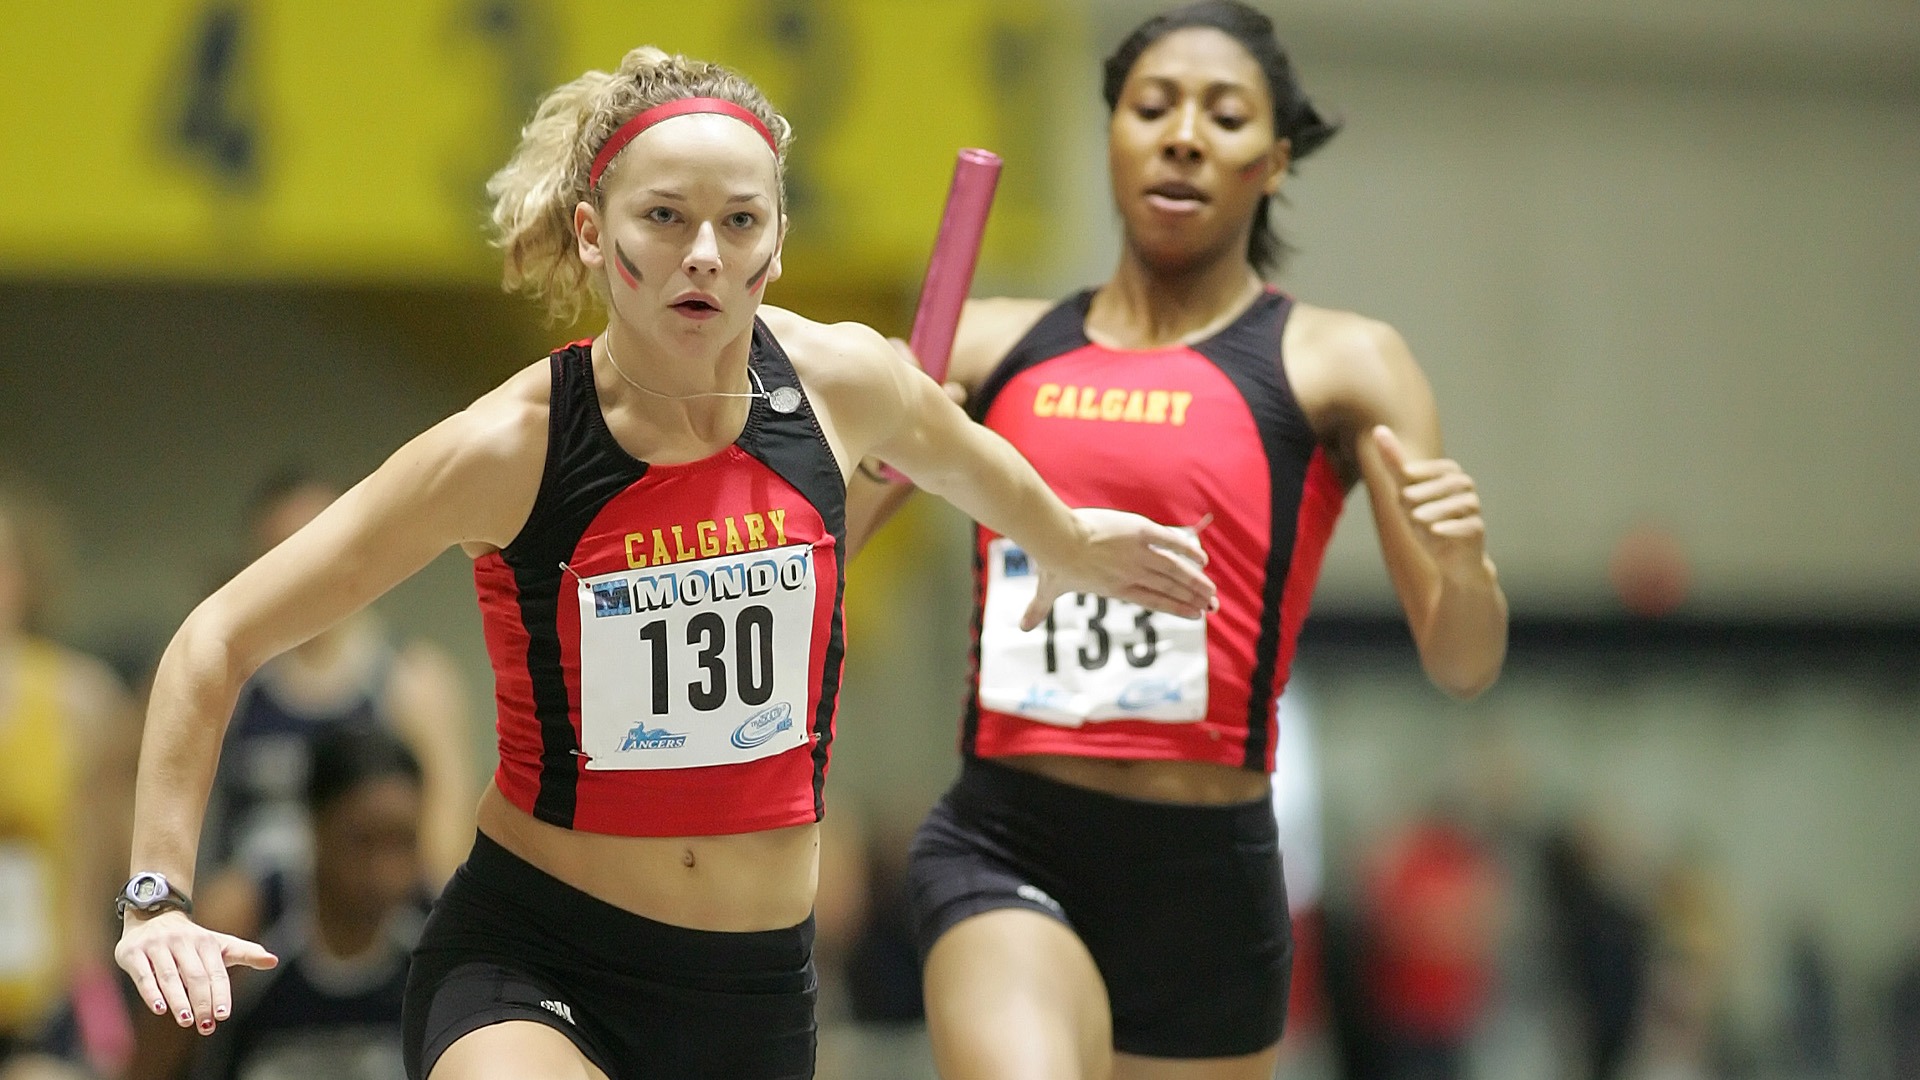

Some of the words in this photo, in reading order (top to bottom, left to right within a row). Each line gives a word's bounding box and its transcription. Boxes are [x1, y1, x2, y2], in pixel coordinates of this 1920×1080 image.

[1033, 383, 1191, 425] CALGARY
[625, 509, 787, 568] CALGARY
[633, 554, 808, 612] MONDO
[640, 605, 774, 714] 130
